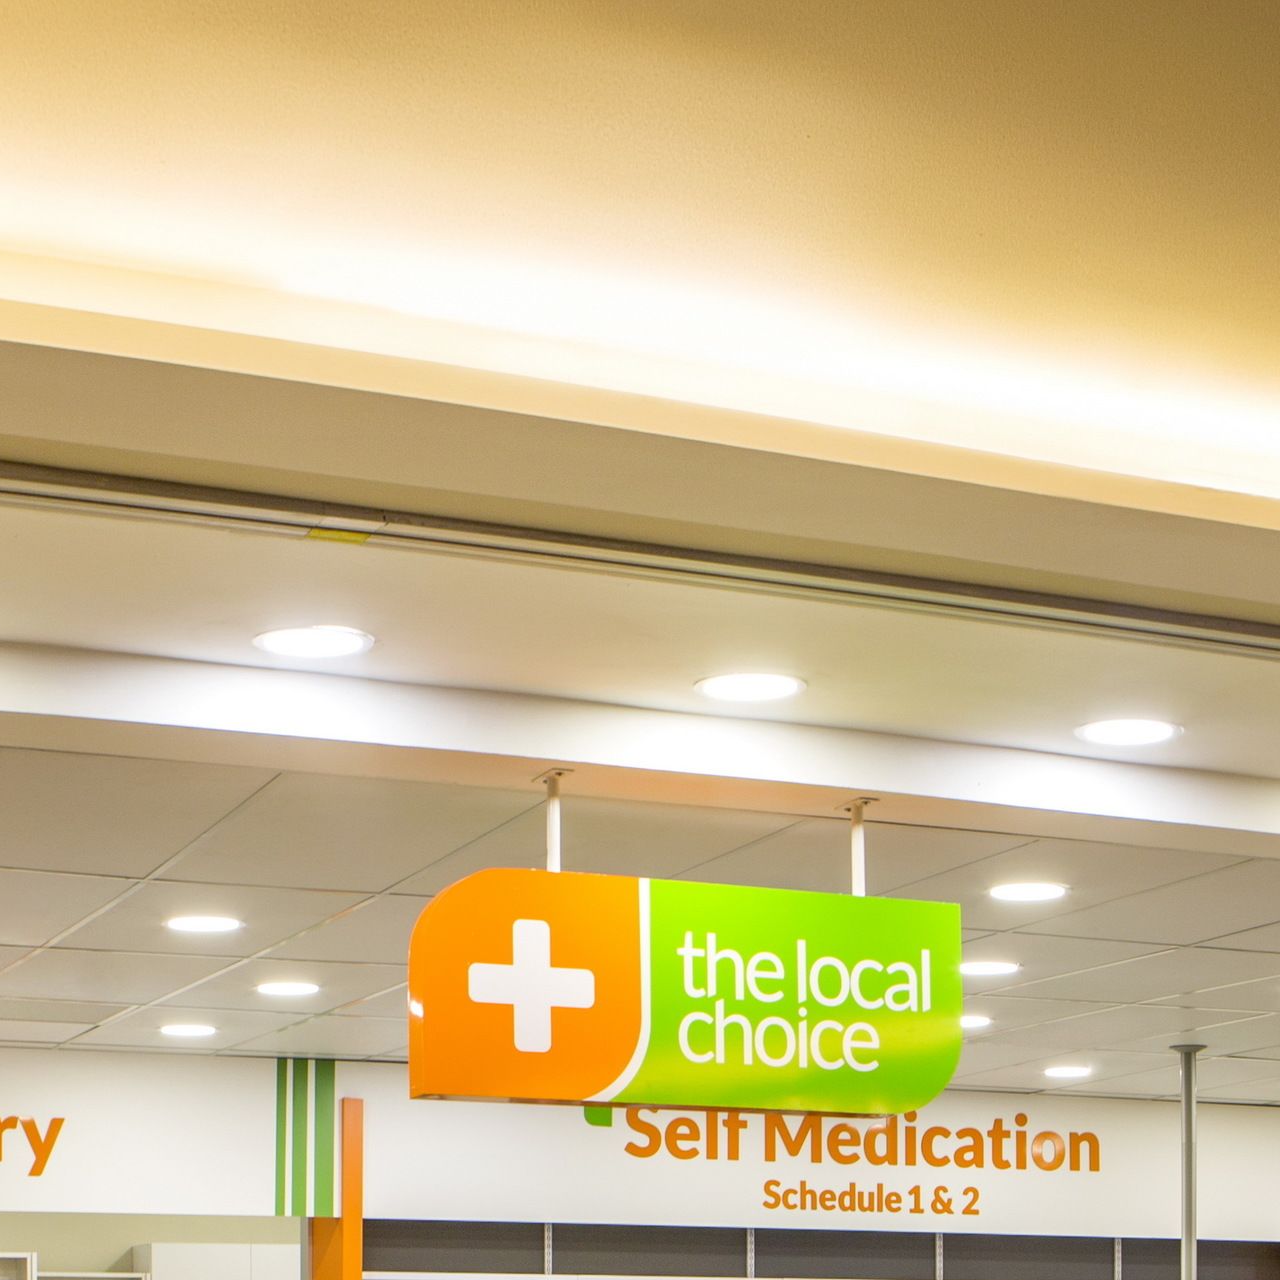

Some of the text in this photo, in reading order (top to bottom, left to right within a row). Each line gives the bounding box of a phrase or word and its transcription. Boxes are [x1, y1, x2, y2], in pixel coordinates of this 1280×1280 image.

[676, 930, 931, 1013] the local
[678, 998, 880, 1073] choice
[624, 1105, 1101, 1172] Self Medication
[762, 1179, 980, 1215] Schedule 1 & 2
